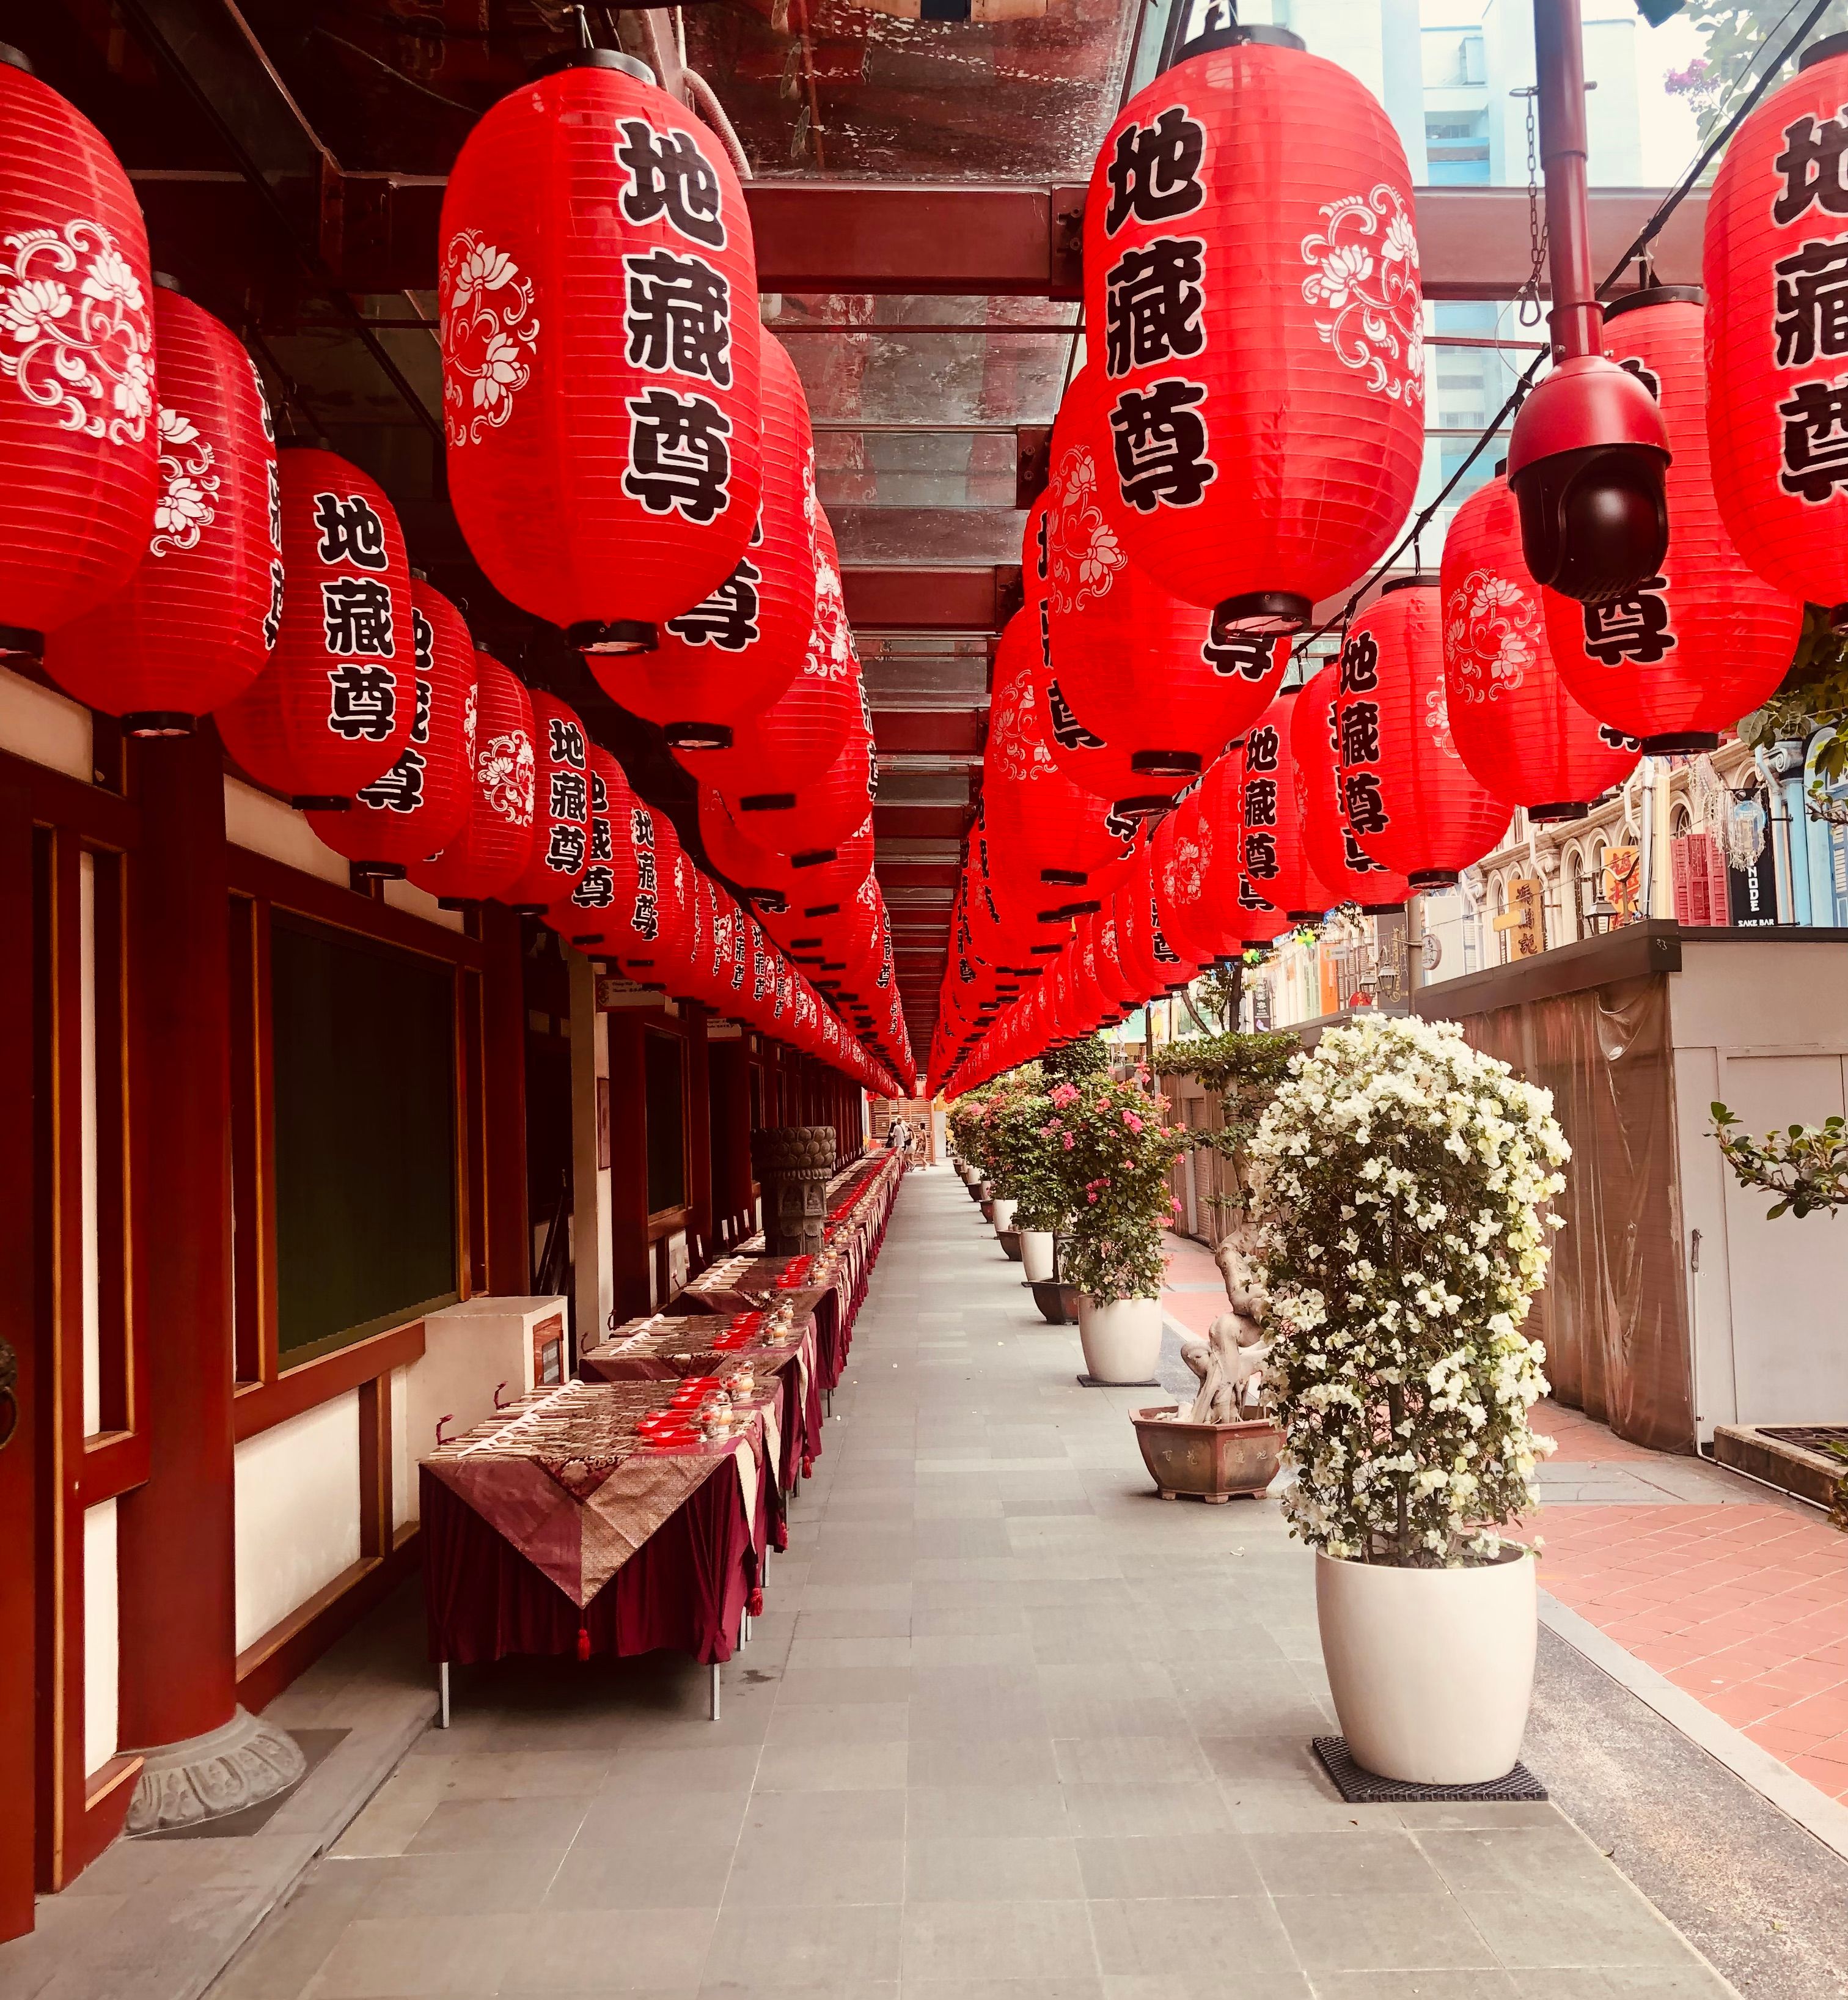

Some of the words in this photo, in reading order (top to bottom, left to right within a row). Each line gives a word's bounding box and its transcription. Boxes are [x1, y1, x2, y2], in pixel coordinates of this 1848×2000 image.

[614, 118, 733, 527] 地藏尊
[1104, 104, 1217, 515] 地藏尊
[312, 492, 397, 741] 地藏尊
[545, 718, 587, 875] 地藏尊
[1244, 726, 1280, 880] 地藏尊
[1340, 630, 1390, 835] 地藏尊
